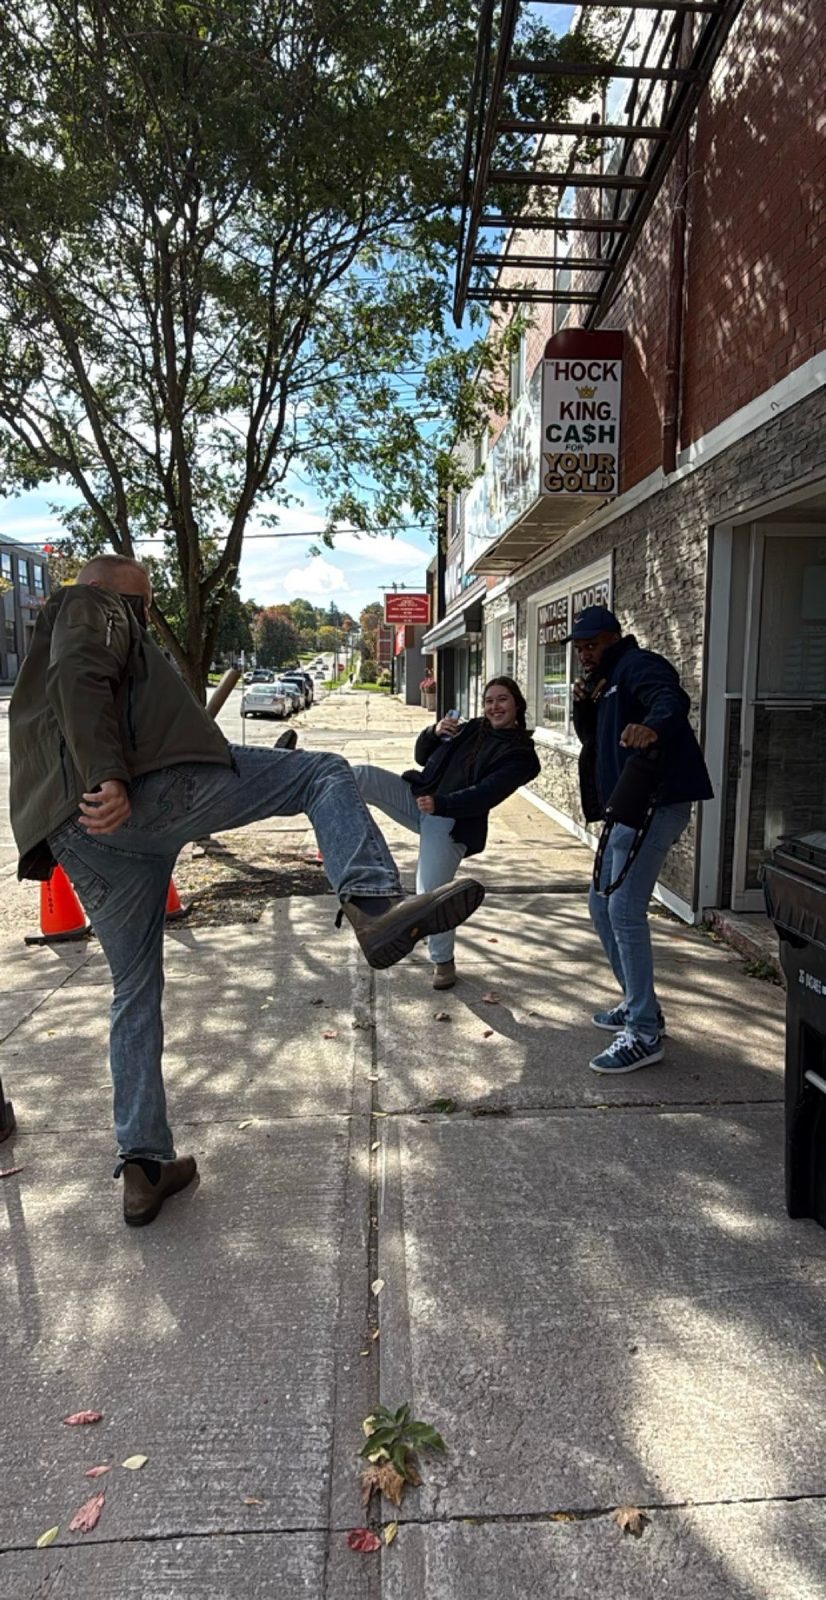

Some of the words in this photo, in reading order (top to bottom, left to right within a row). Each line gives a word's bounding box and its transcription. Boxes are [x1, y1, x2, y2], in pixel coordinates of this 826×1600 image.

[554, 361, 618, 382] HOCK
[560, 401, 611, 421] KING
[545, 423, 616, 446] CA$H
[565, 443, 584, 451] FOR
[543, 453, 616, 474] YOUR
[544, 472, 614, 493] GOLD
